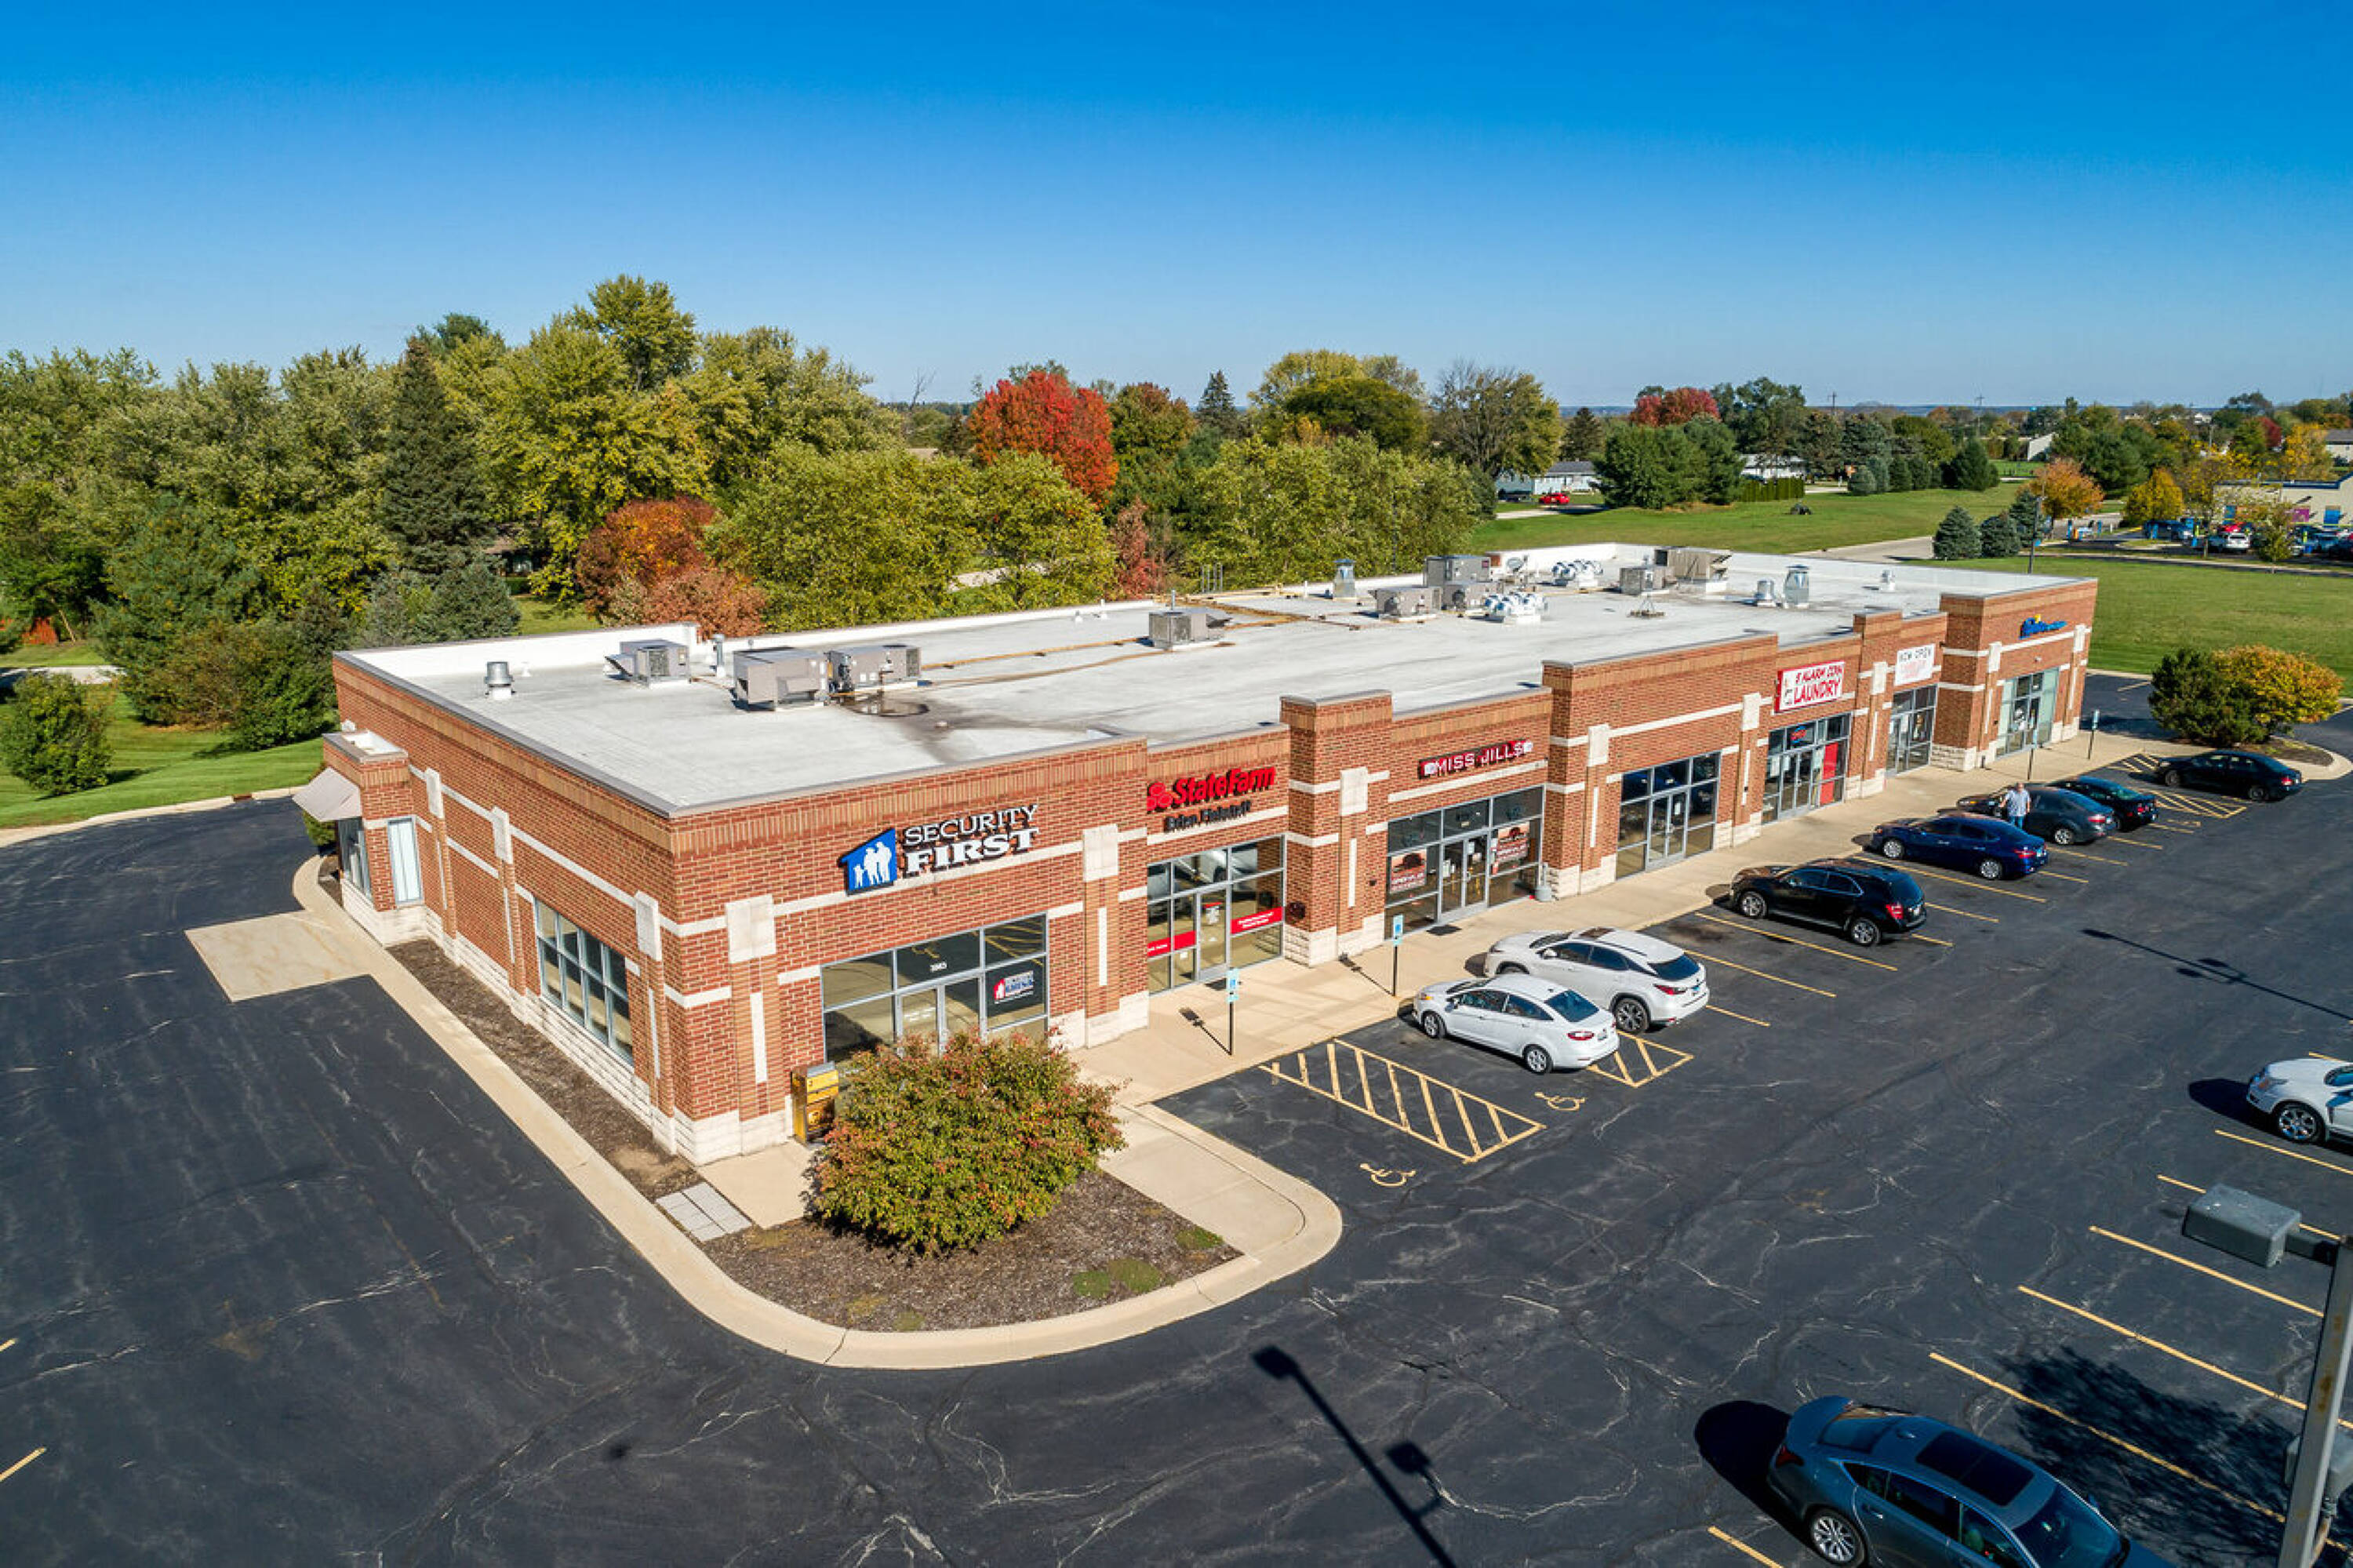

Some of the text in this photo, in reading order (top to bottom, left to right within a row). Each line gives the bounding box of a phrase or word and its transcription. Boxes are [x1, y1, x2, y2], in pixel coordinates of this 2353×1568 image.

[1794, 677, 1841, 704] LAUNDRY
[1435, 752, 1475, 773] MISS
[904, 803, 1039, 846] SECURITY
[904, 826, 1040, 875] FIRST
